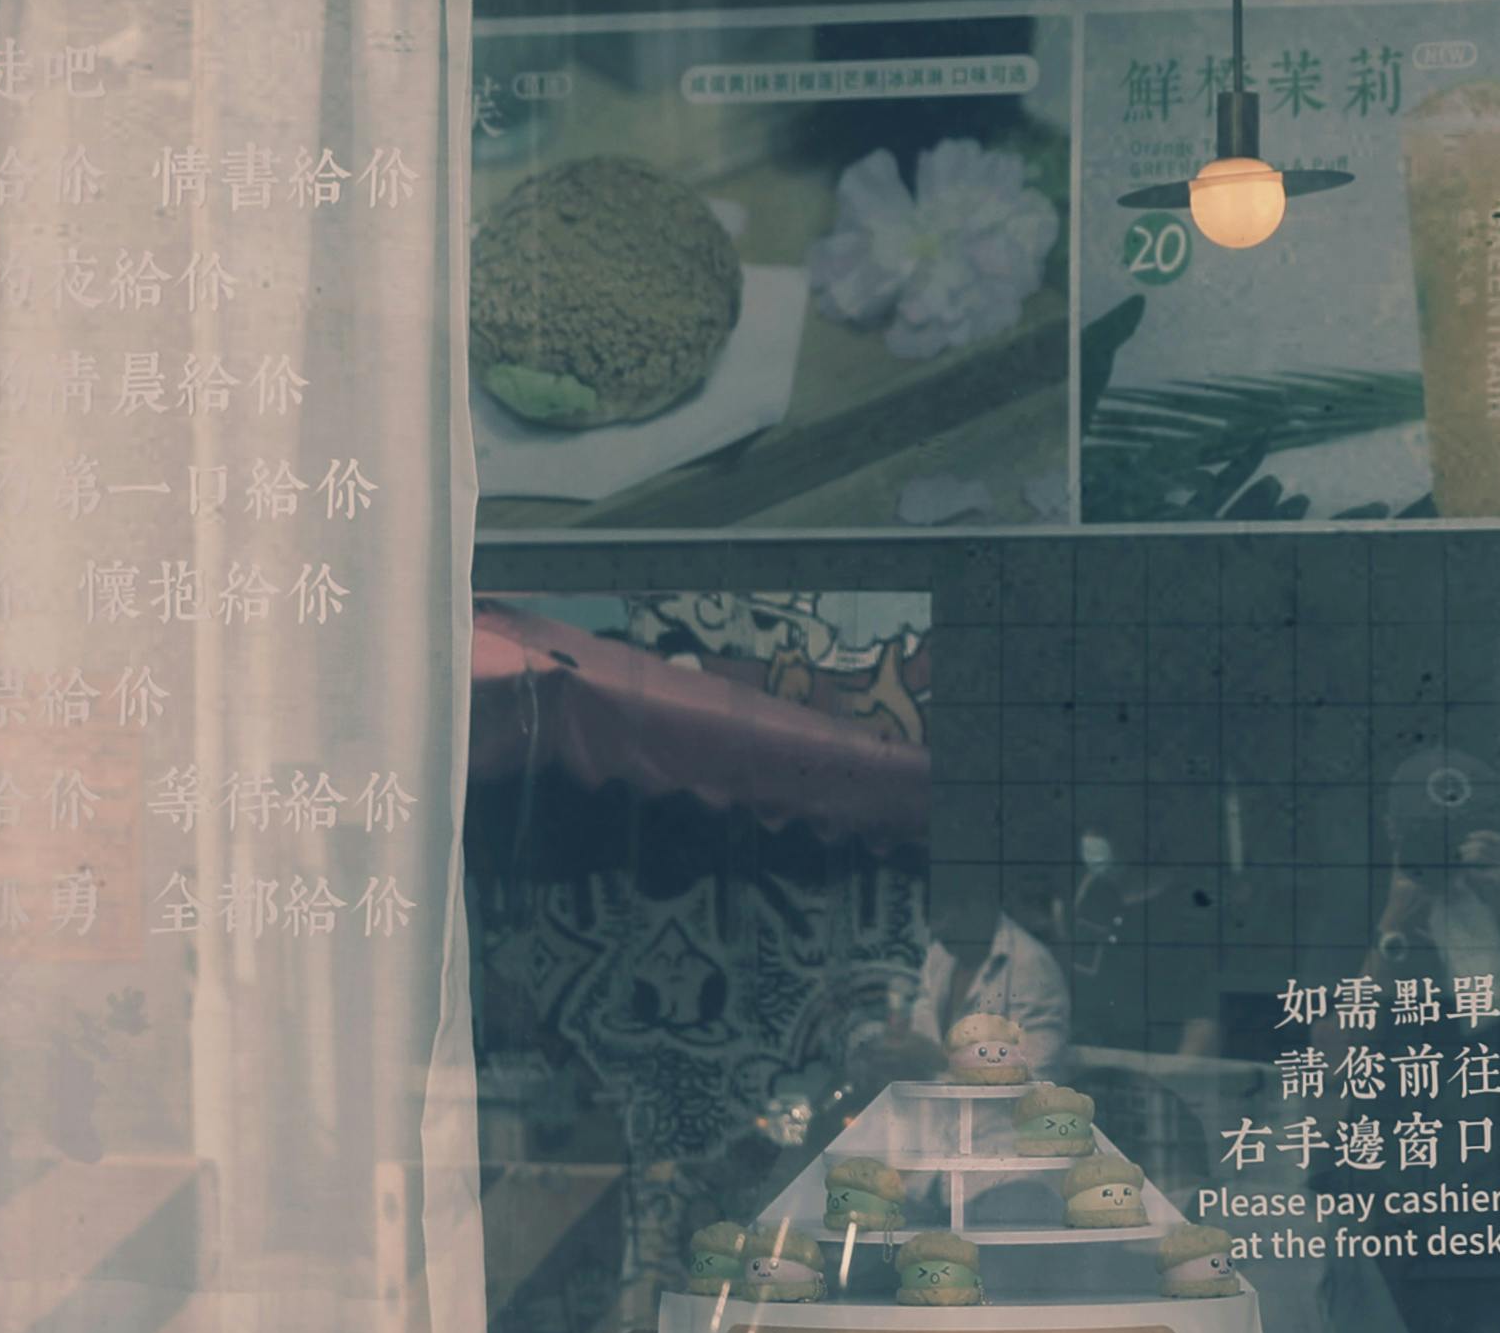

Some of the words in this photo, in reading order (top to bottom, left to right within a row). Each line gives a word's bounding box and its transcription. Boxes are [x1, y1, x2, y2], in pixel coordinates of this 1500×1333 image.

[151, 141, 420, 211] 情書給你
[1128, 222, 1188, 274] 20
[1219, 1111, 1494, 1171] 右手邊窗口
[1198, 1187, 1305, 1217] Please
[1315, 1193, 1374, 1224] pay
[1230, 1232, 1262, 1260] at
[1271, 1227, 1326, 1259] the
[1334, 1226, 1417, 1258] front
